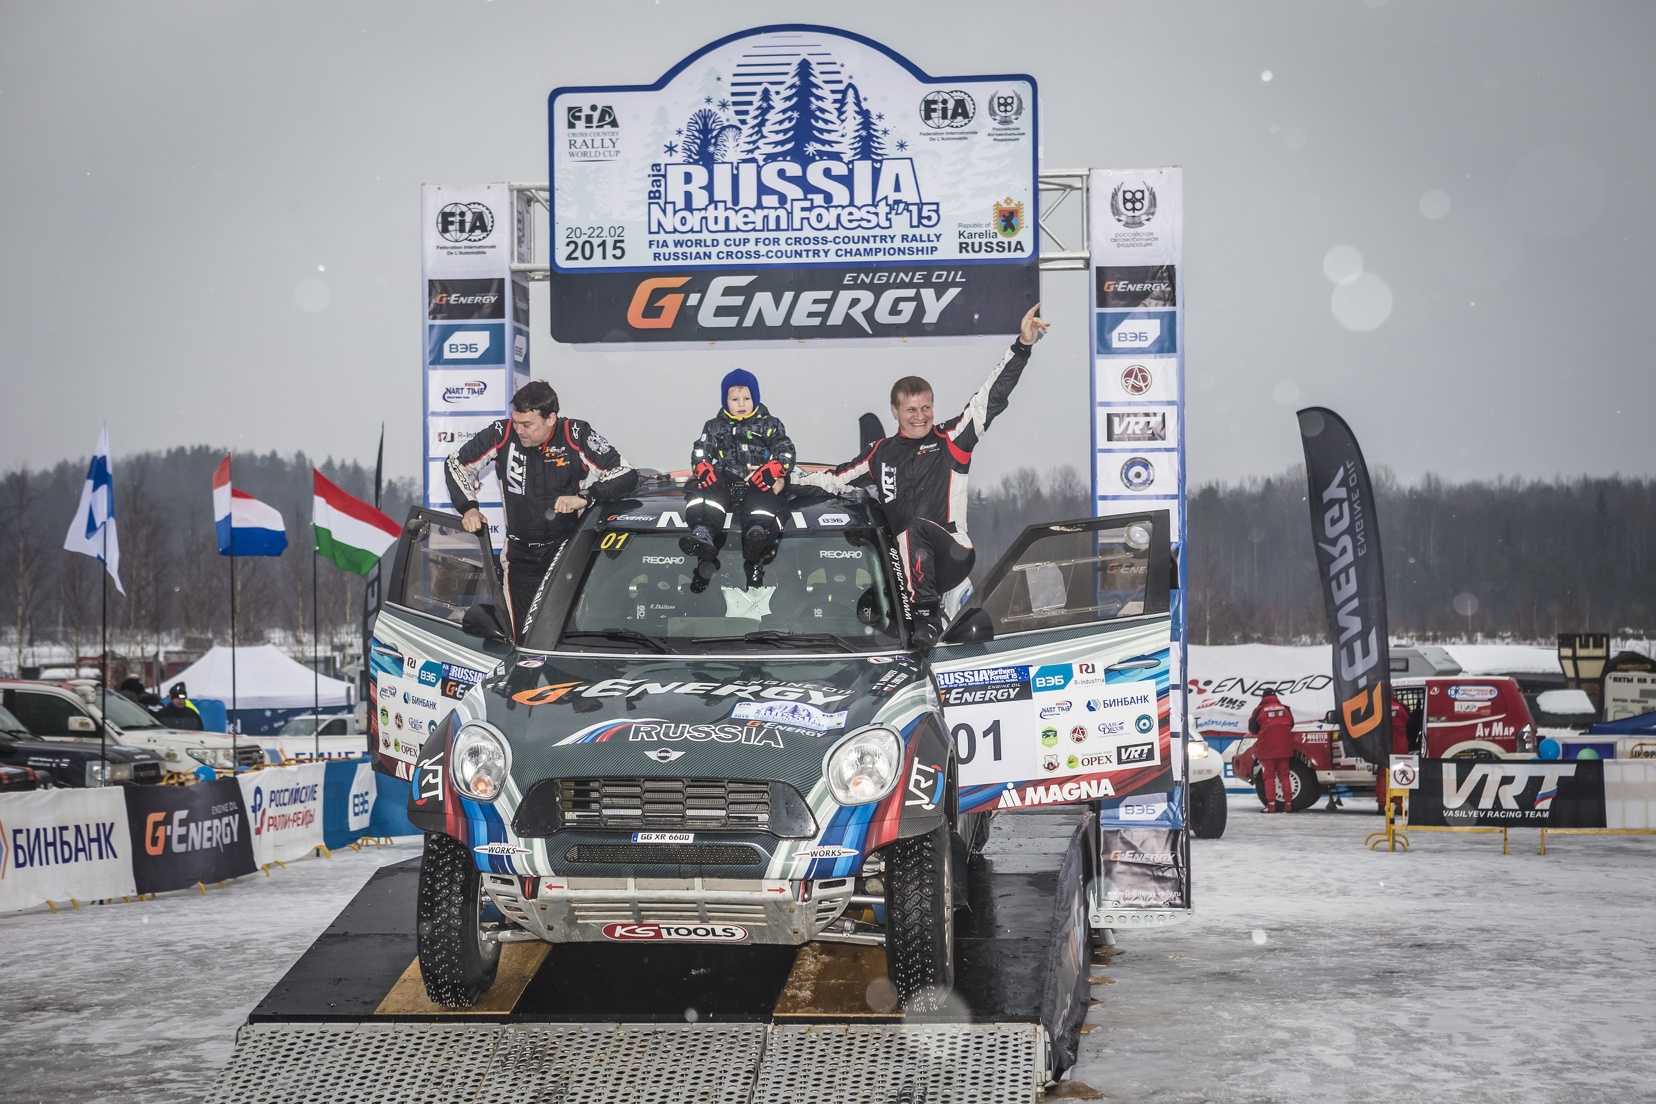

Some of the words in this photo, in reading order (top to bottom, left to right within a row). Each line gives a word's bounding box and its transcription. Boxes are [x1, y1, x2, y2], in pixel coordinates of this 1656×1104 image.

[568, 138, 620, 149] RALLY
[648, 163, 666, 200] Baja
[664, 158, 923, 208] RUSSIA
[648, 200, 791, 234] Northern
[790, 199, 892, 231] Forest
[565, 226, 625, 239] 20-22.02
[958, 229, 998, 240] Karelia
[649, 239, 669, 249] FIA
[673, 239, 720, 249] WORLD
[724, 238, 751, 248] CUP
[755, 237, 780, 248] FOR
[785, 234, 896, 247] CROSS-COUNTRY
[900, 233, 942, 244] RALLY
[958, 240, 1025, 254] RUSSIA
[565, 239, 626, 261] 2015
[652, 250, 712, 262] RUSSIAN
[716, 249, 829, 260] CROSS-COUNTRY
[835, 246, 938, 258] CHAMPIONSHIP
[842, 272, 927, 285] ENGINE
[933, 271, 967, 282] OIL
[1117, 332, 1149, 342] ВЭБ
[600, 532, 630, 549] 01
[642, 556, 685, 565] RECARO
[820, 550, 863, 559] RECARO
[936, 669, 989, 686] RUSSIA
[1036, 675, 1065, 687] ВЭБ
[733, 680, 817, 688] ENGINE
[822, 687, 856, 696] OIL
[411, 695, 438, 711] БИНБАНК
[1103, 694, 1150, 709] БИНБАНК
[629, 723, 784, 749] RUSSIA
[951, 719, 1002, 765] 01
[1120, 744, 1153, 760] VRT
[905, 756, 935, 808] VRT
[1442, 762, 1577, 811] VRT
[269, 782, 319, 808] РОССИЙСКИЕ
[1024, 779, 1116, 806] MAGNA
[267, 807, 315, 833] РАЛЛИ-РЕЙДЫ
[1442, 809, 1486, 818] VASILYEV
[1487, 810, 1522, 818] RACING
[1524, 810, 1550, 818] TEAM
[12, 822, 118, 868] БИНБАНК
[640, 833, 653, 841] GG
[654, 833, 667, 841] XR
[488, 845, 516, 856] WORKS
[809, 847, 843, 858] WORKS
[614, 925, 660, 938] KS
[659, 926, 739, 939] TOOLS
